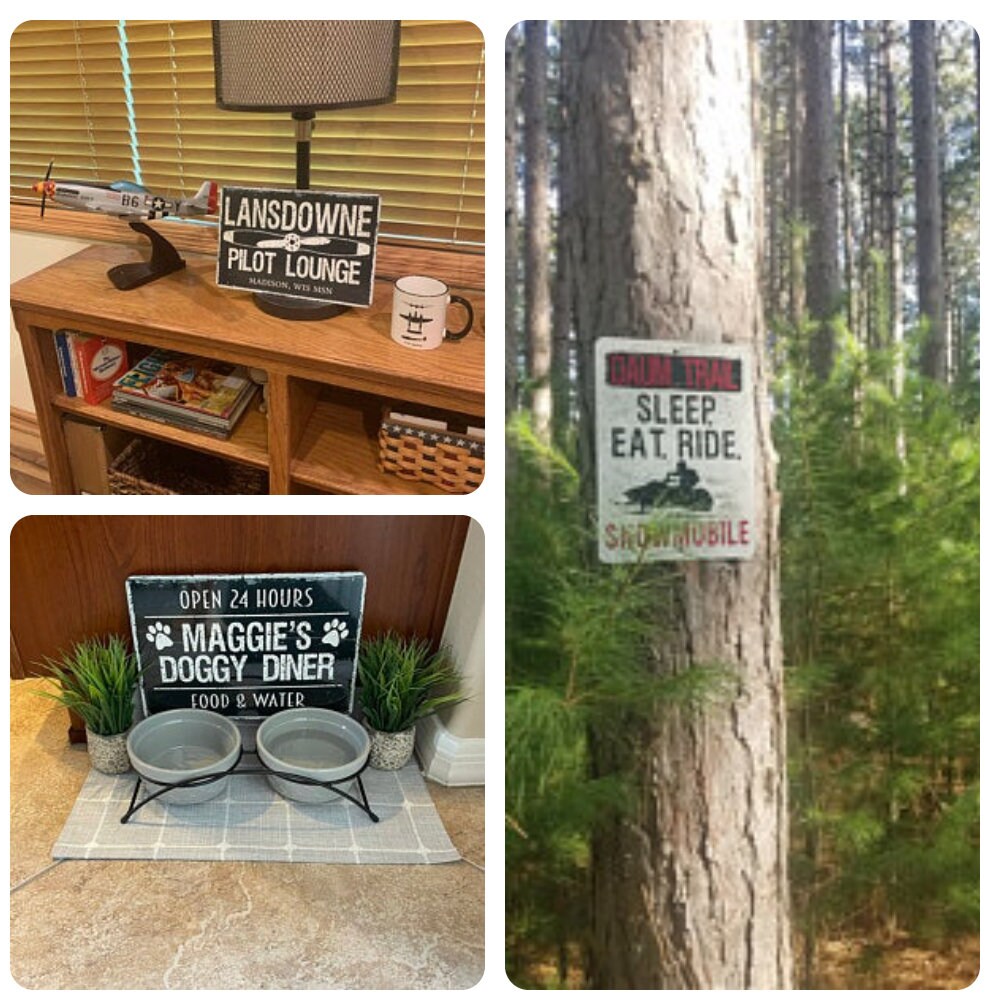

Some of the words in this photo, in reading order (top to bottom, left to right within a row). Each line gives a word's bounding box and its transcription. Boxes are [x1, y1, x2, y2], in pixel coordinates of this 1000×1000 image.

[223, 197, 374, 238] LANSDOWNE
[227, 248, 277, 275] PILOT
[285, 254, 362, 285] LOUNGE
[248, 277, 291, 290] MADISON,
[683, 356, 739, 390] TRAIL
[611, 427, 667, 460] EAT.
[678, 430, 742, 460] RIDE.
[180, 590, 222, 609] OPEN
[230, 589, 249, 608] 24
[256, 587, 314, 608] HOURS
[182, 621, 312, 653] MAGGIE'S
[160, 655, 248, 683] DOGGY
[262, 653, 335, 682] DINER
[191, 693, 230, 709] FOOD
[236, 693, 247, 707] &
[252, 691, 305, 708] WATER
